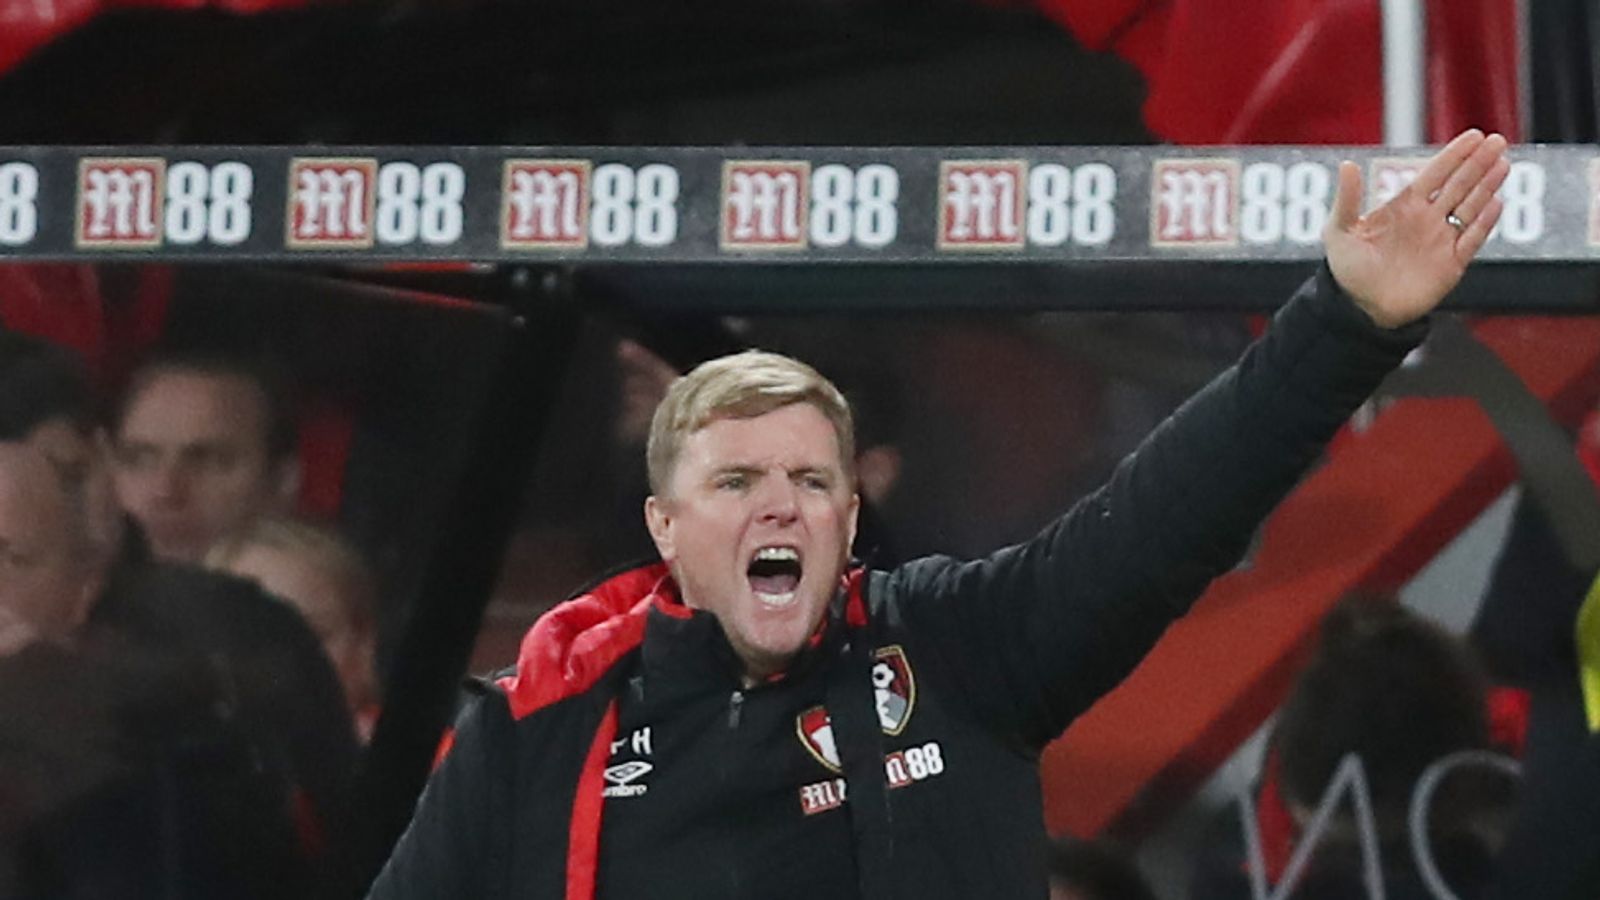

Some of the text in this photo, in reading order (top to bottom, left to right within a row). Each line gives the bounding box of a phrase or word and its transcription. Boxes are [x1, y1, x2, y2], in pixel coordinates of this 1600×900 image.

[84, 161, 254, 246] M88
[295, 161, 465, 246] M88
[508, 163, 680, 247] M88
[725, 163, 900, 247] M88
[946, 163, 1118, 247] M88
[1157, 162, 1330, 246] M88
